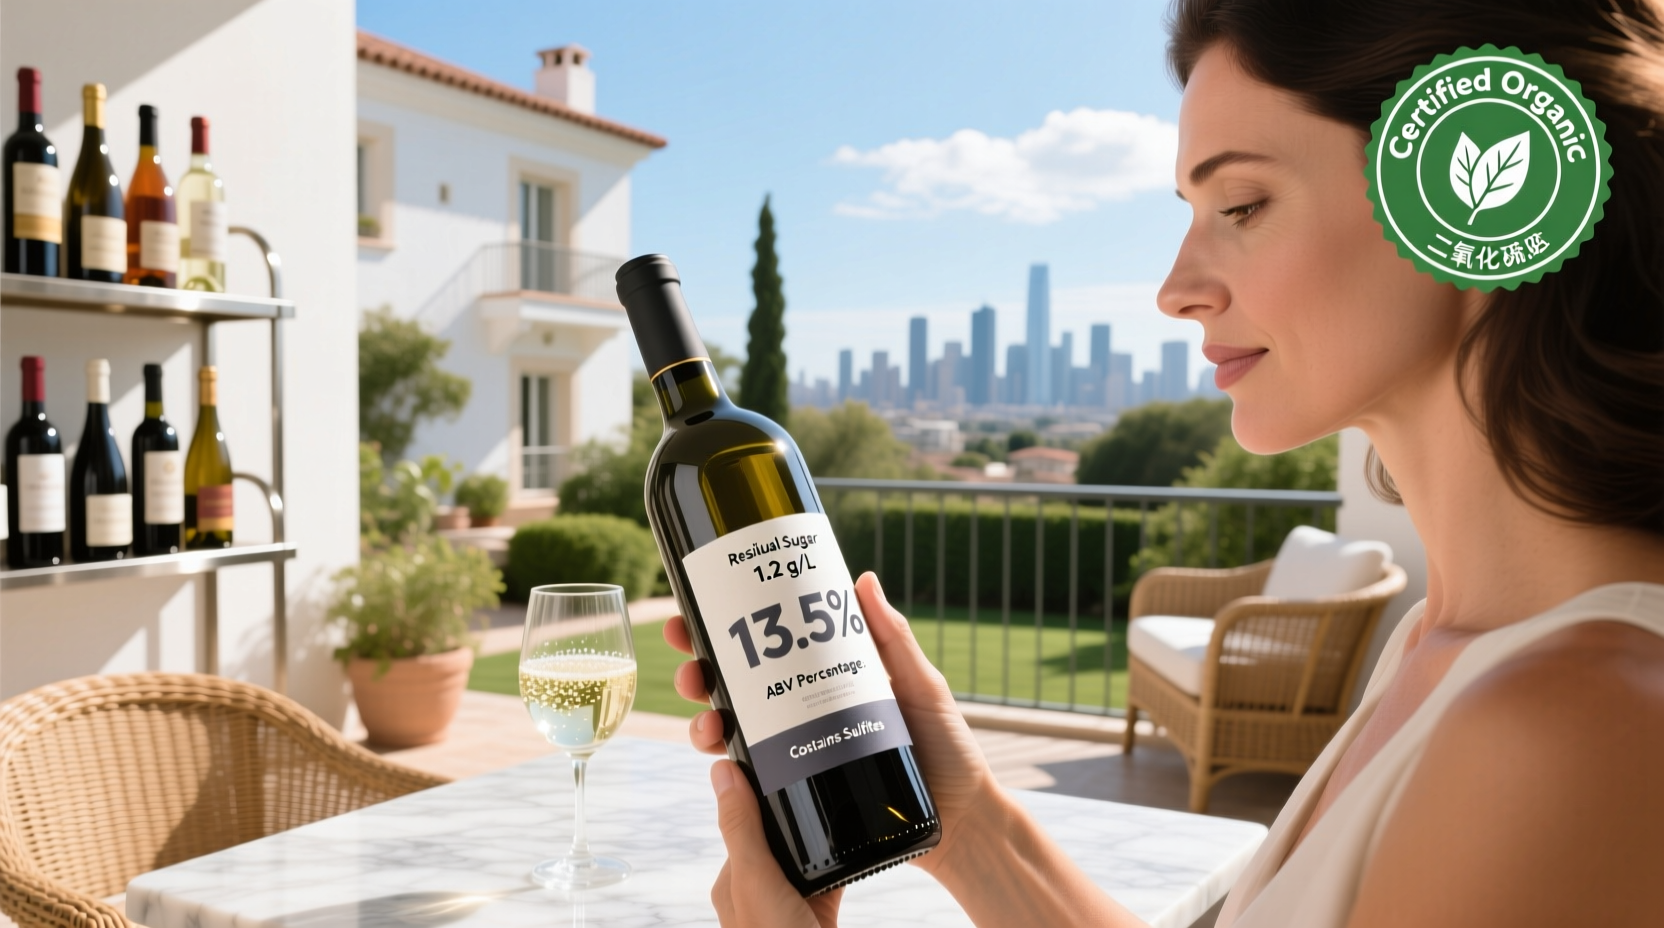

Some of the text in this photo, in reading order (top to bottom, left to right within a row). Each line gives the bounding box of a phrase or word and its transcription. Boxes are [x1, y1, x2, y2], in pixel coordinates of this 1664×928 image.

[753, 552, 817, 582] 1.2 g/L
[728, 589, 864, 669] 13.5%
[766, 677, 793, 700] ABV
